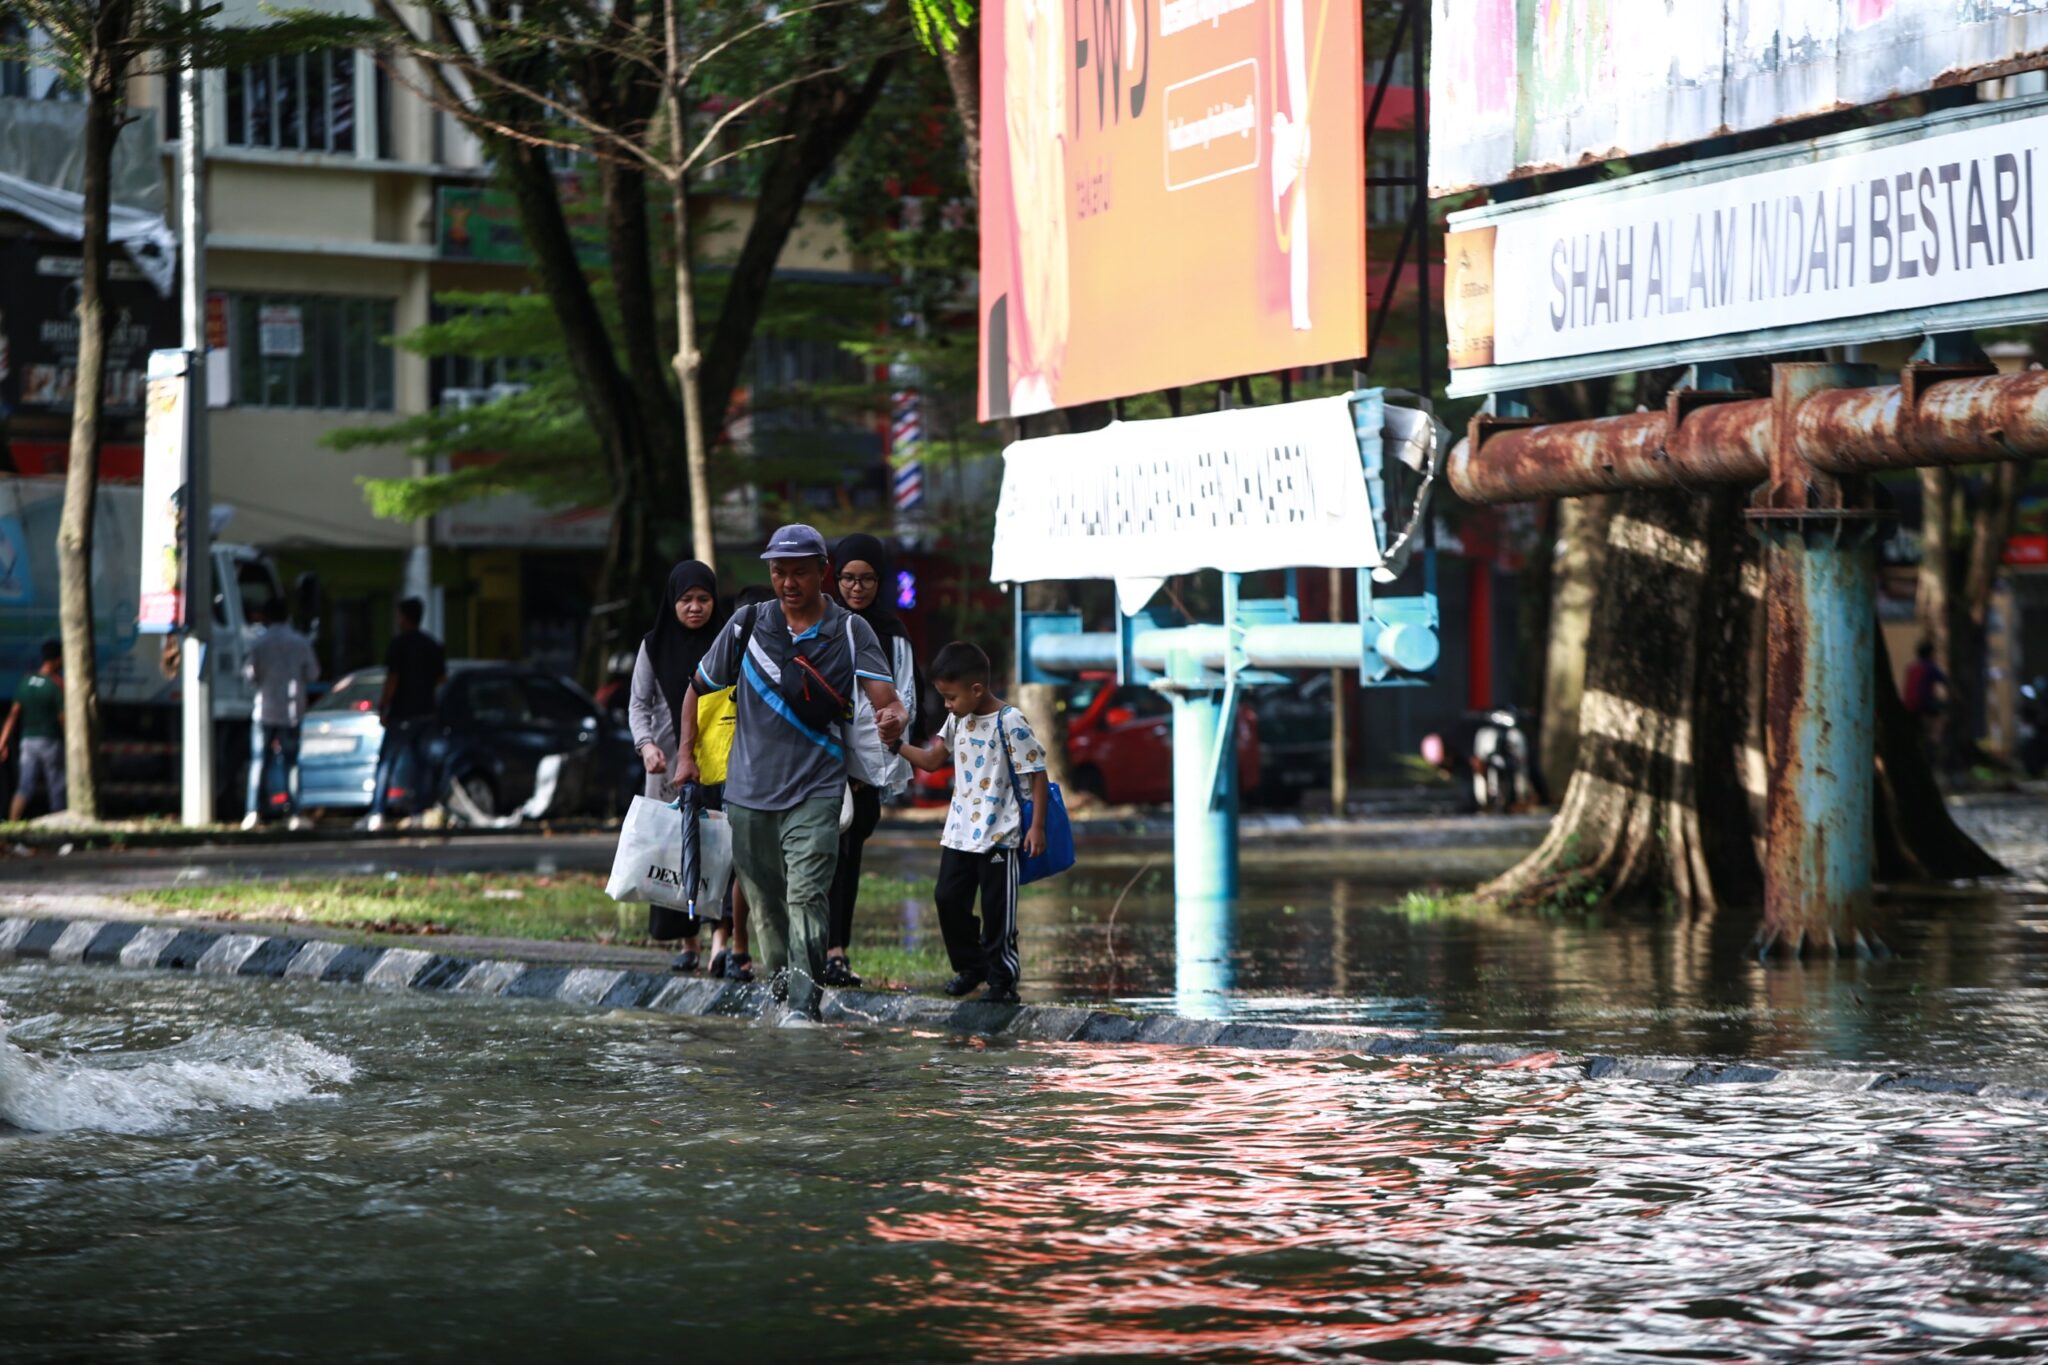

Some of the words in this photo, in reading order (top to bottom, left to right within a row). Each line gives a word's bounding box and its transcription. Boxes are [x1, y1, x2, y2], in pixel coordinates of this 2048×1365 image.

[1549, 224, 1635, 333] SHAH
[1643, 206, 1737, 319] ALAM
[1749, 183, 1856, 303] INDAH
[1869, 148, 2035, 284] BESTARI
